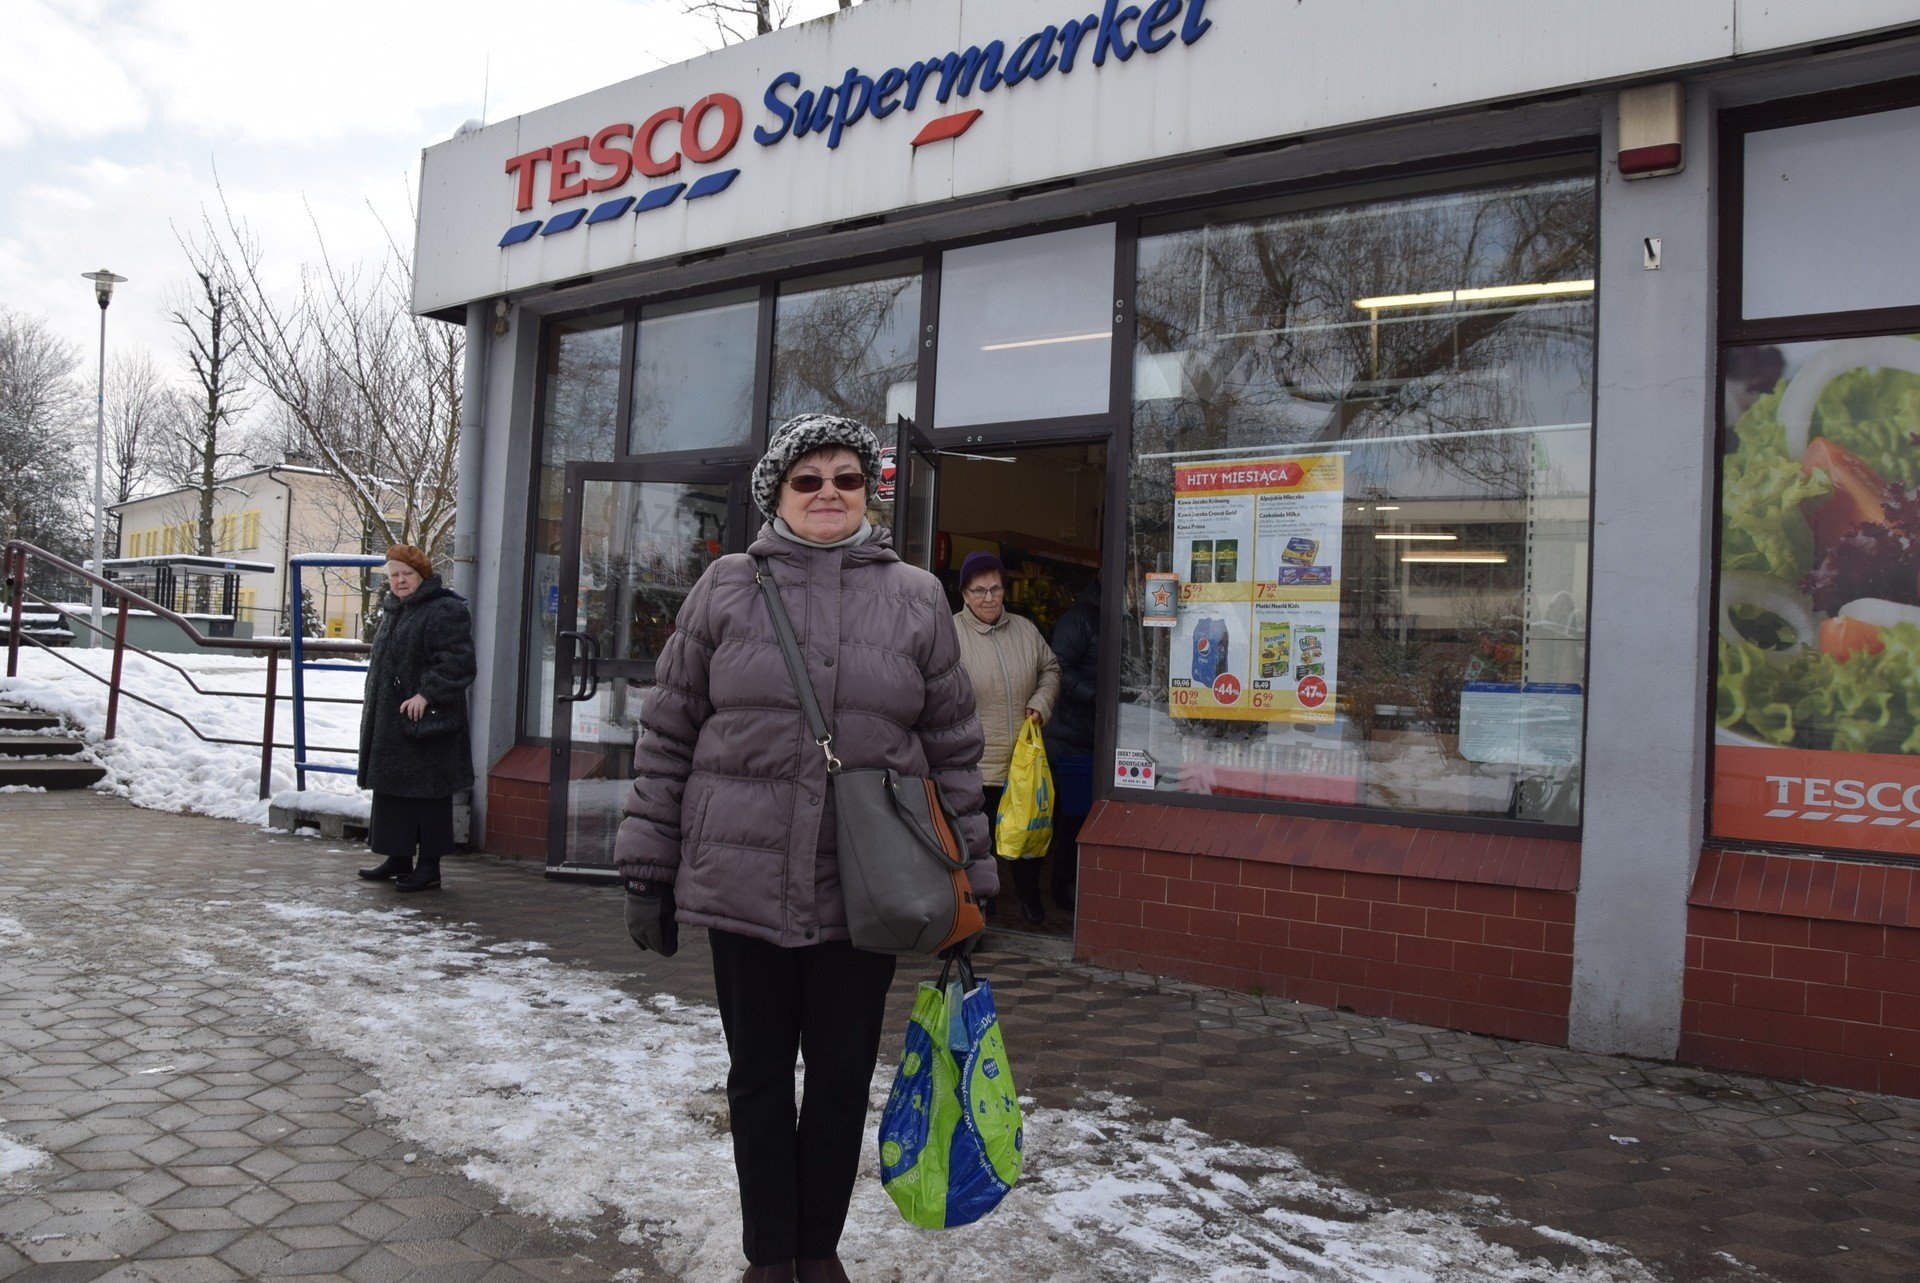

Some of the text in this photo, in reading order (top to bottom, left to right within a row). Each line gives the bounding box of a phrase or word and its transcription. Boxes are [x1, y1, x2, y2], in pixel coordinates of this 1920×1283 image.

[505, 0, 1213, 213] TESCO Supermarket
[1187, 469, 1288, 487] HITY MIESIĄCA
[1256, 583, 1267, 599] 7
[1172, 690, 1189, 705] 10
[1214, 683, 1240, 696] -44%
[1301, 685, 1324, 698] -17%
[1253, 692, 1262, 708] 6
